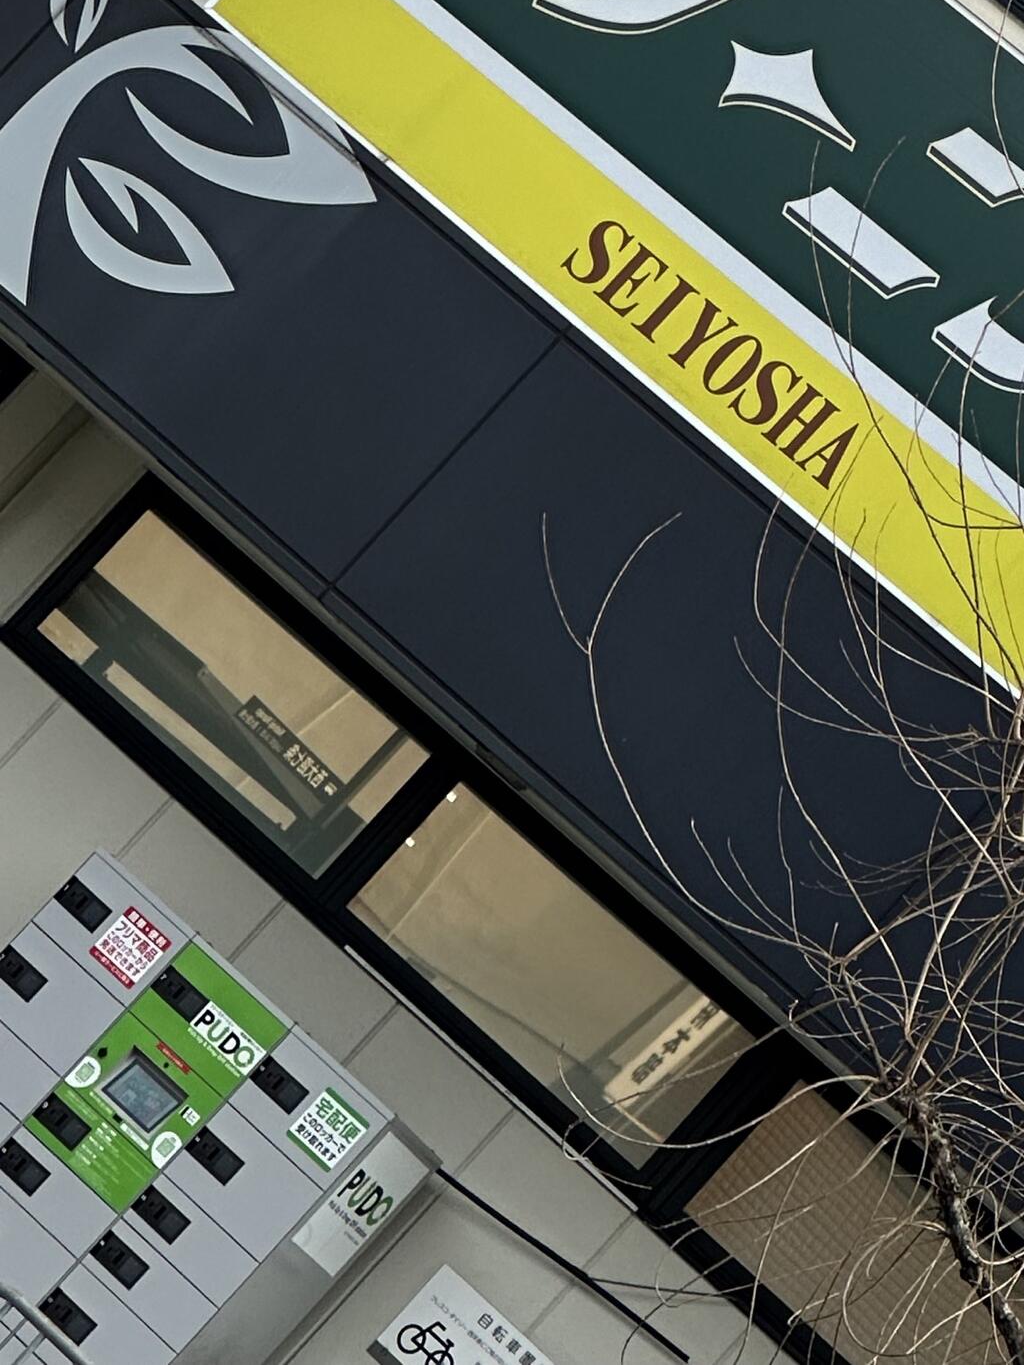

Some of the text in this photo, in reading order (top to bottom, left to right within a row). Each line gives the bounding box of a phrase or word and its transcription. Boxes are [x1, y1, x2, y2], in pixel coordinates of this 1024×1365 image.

[560, 220, 859, 490] SEIYOSHA
[98, 938, 141, 977] 発送できます
[106, 932, 149, 970] このロッカーから
[115, 920, 157, 962] フリマ商品
[193, 1009, 255, 1068] PUDO
[296, 1123, 338, 1162] 受け取れます
[302, 1112, 347, 1154] このロッカーで
[315, 1097, 362, 1144] 宅配便
[337, 1168, 394, 1226] PUDO
[477, 1313, 543, 1365] 自転車置
